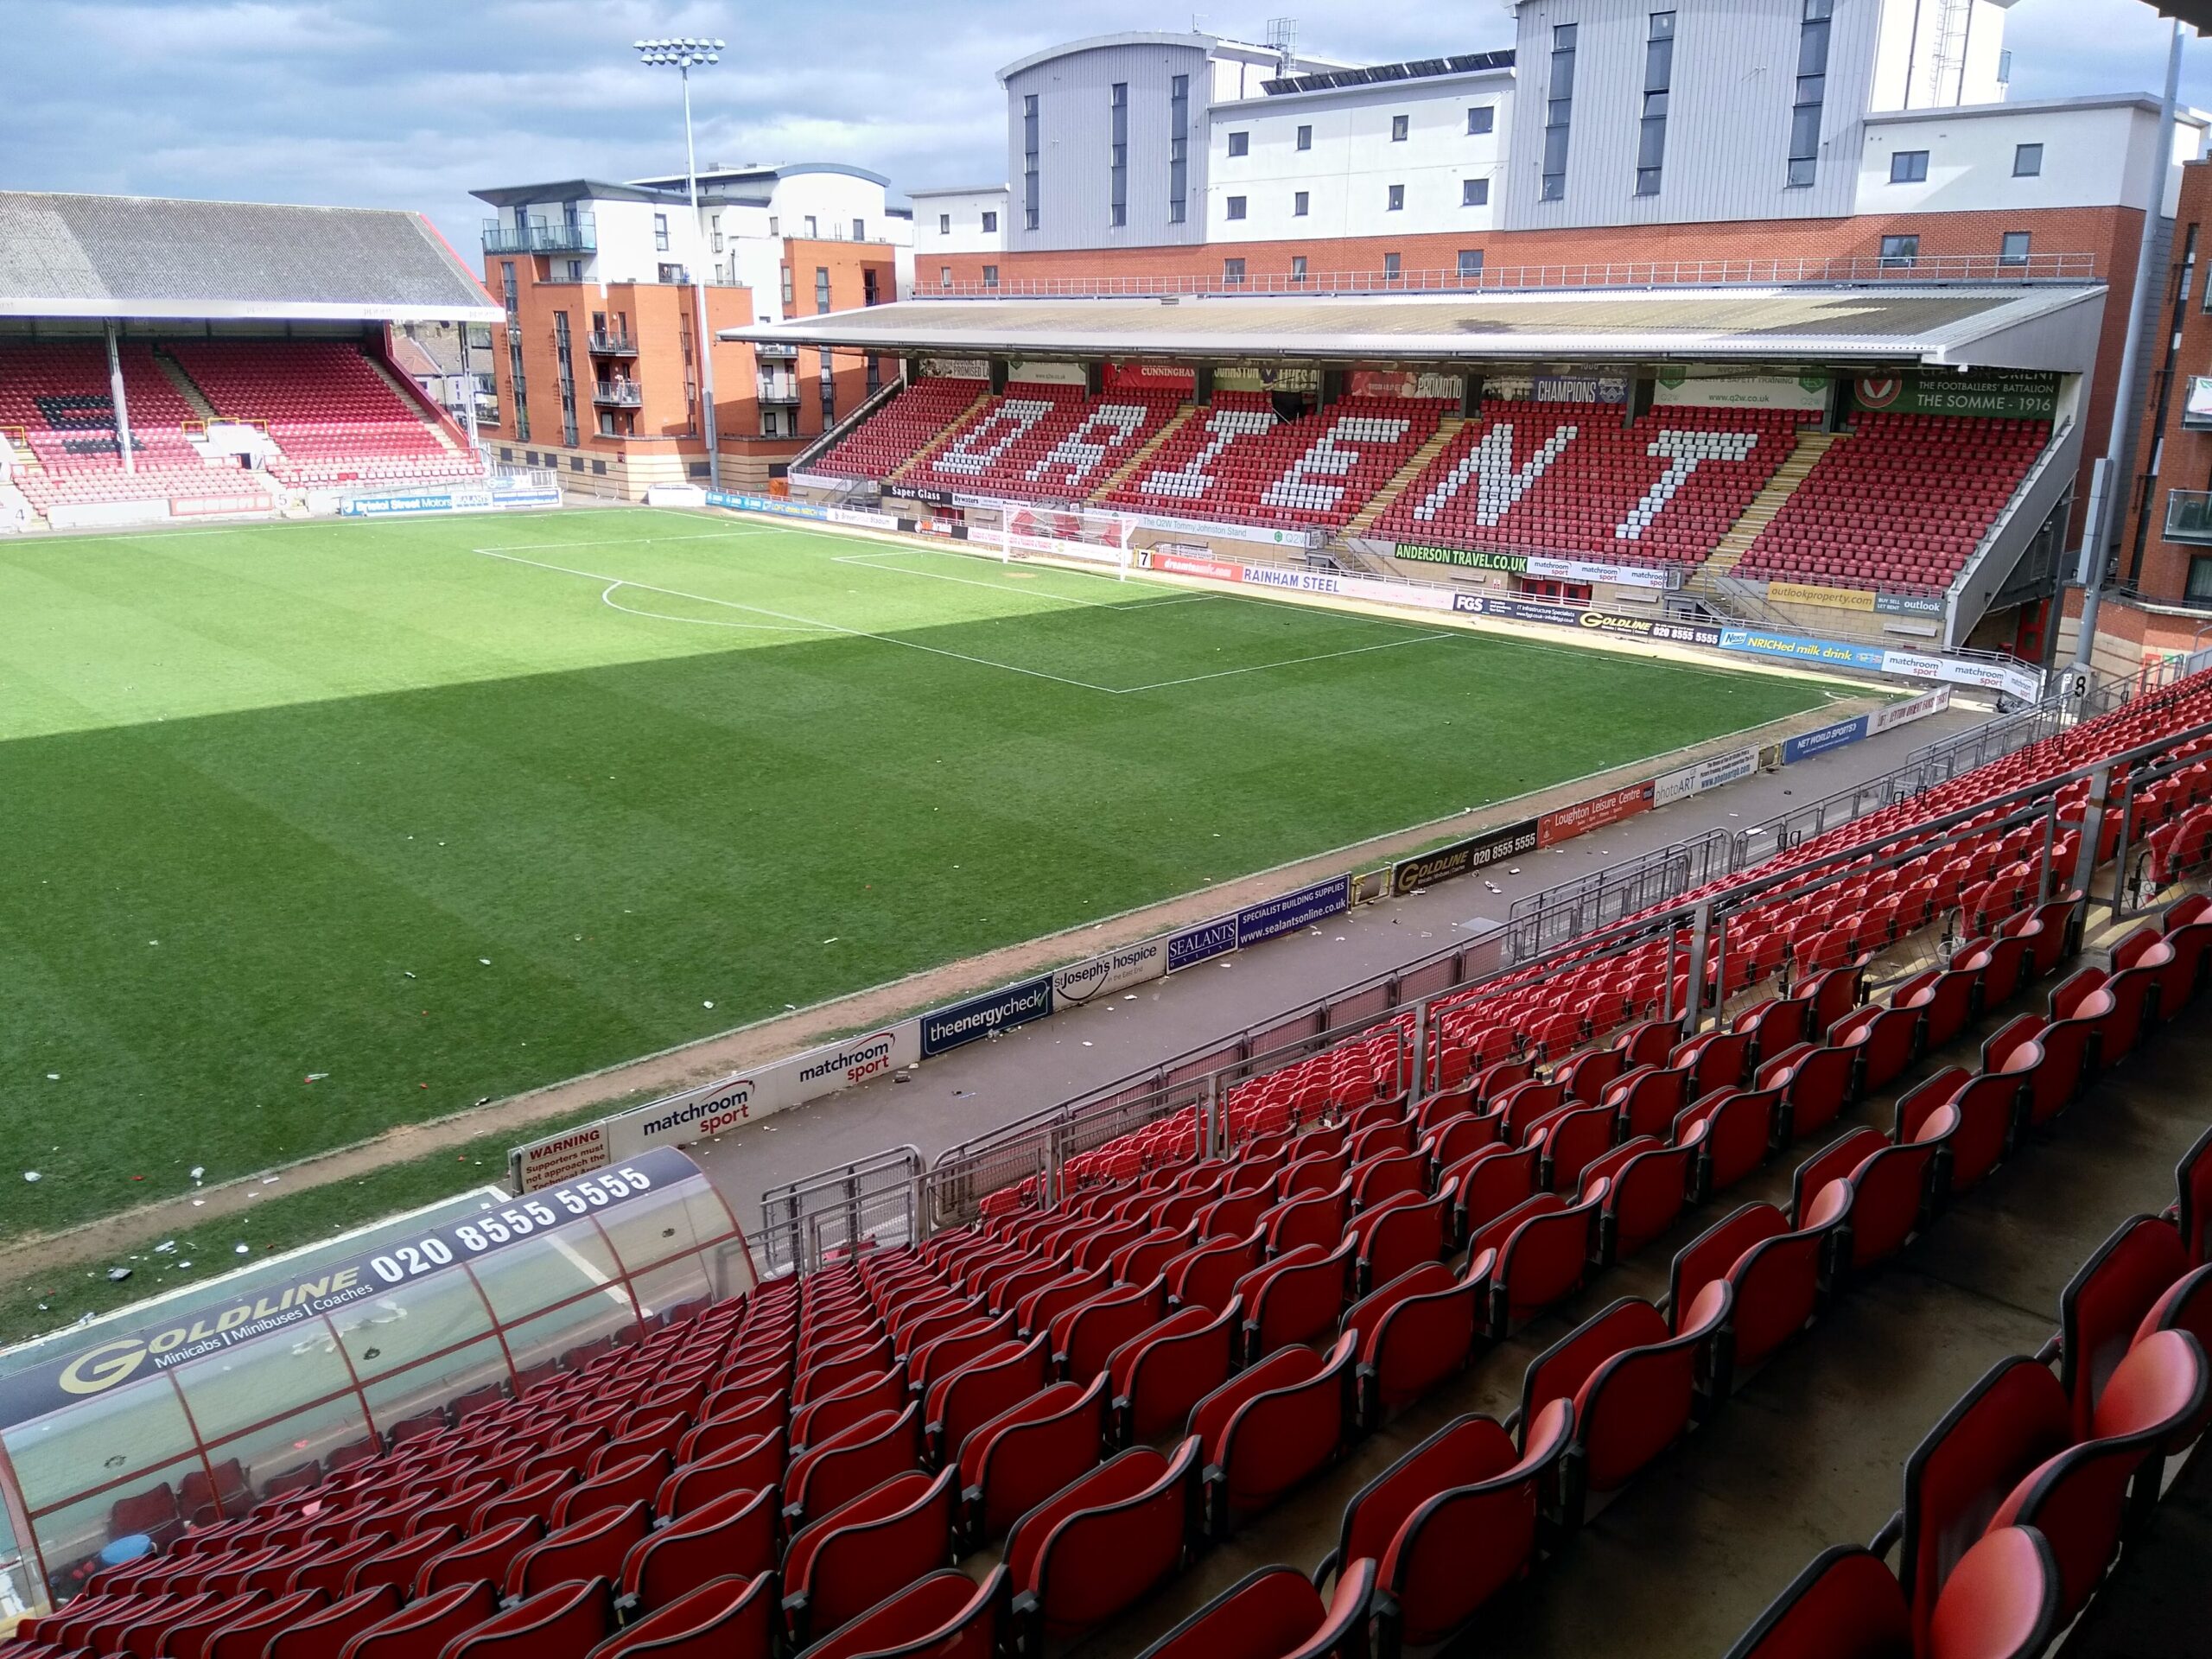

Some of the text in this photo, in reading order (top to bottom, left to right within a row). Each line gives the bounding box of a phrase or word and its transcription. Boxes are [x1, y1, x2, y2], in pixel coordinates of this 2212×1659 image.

[953, 365, 982, 377] PROMISED
[1537, 380, 1596, 403] CHAMPIONS
[1937, 382, 2000, 392] FOOTBALLERS'
[2003, 384, 2054, 393] BATTALION
[1708, 394, 1770, 403] www.q2w.co.uk
[1917, 394, 2050, 411] THE SOMME 1916
[422, 498, 452, 507] Motors
[892, 486, 915, 499] Saper
[918, 489, 941, 500] Glass
[954, 495, 979, 505] Bywaters
[1143, 518, 1155, 526] The
[1173, 521, 1196, 533] Tommy
[1196, 524, 1225, 535] Johnston
[1227, 527, 1247, 537] Stand
[1141, 552, 1148, 565] 7
[1395, 544, 1527, 572] ANDERSON TRAVEL.CO.UK
[1535, 560, 1569, 570] matchroom
[1244, 569, 1339, 593] RAINHAM STEEL
[1581, 566, 1618, 575] matchroom
[1599, 574, 1618, 582] sport
[1457, 596, 1484, 612] FGS
[1771, 587, 1872, 606] outlookproperty.com
[1904, 600, 1941, 613] outlook
[1522, 605, 1552, 614] Infrastructure
[1551, 609, 1575, 618] Specialists
[1580, 612, 1653, 631] GOLDLINE
[1653, 627, 1670, 638] 020
[1671, 629, 1694, 641] 8555
[1695, 633, 1718, 645] 5555
[1747, 637, 1853, 661] NRICHed milk drink
[1889, 657, 1939, 670] matchroom
[1913, 667, 1937, 677] sport
[1955, 666, 2004, 680] matchroom
[1980, 677, 2003, 687] sport
[2011, 677, 2031, 690] matchroom
[2074, 676, 2086, 697] 8
[2019, 690, 2031, 699] sport
[1890, 707, 1907, 723] LEYTON
[1906, 702, 1922, 715] ORIENT
[1797, 738, 1814, 749] NET
[1815, 731, 1831, 747] WORLD
[1831, 724, 1853, 738] SPORTS
[1700, 764, 1751, 789] www.photoartgb.com
[1656, 775, 1696, 803] photoART
[1555, 806, 1590, 827] Loughton
[1592, 796, 1617, 814] Leisure
[1618, 788, 1641, 805] Centre
[1473, 849, 1491, 866] 020
[1492, 841, 1513, 860] 8555
[1514, 833, 1535, 851] 5555
[1398, 850, 1470, 891] GOLDLINE
[1243, 881, 1344, 924] SPECIALIST BUILDING SUPPLIES
[1240, 899, 1346, 944] www.sealantsonline.co.uk
[1169, 922, 1236, 957] SEALANTS
[1113, 944, 1157, 970] hospice
[1113, 972, 1122, 982] the
[1122, 969, 1135, 979] East
[1135, 966, 1143, 976] End
[931, 990, 1042, 1042] theenergycheck
[800, 1041, 888, 1082] matchroom
[847, 1055, 889, 1082] sport
[644, 1090, 747, 1136] matchroom
[700, 1103, 749, 1134] sport
[530, 1129, 600, 1160] WARNING
[526, 1143, 604, 1174] Supporters must
[526, 1154, 606, 1185] not approach the
[370, 1167, 652, 1283] 020 8555 5555
[59, 1265, 360, 1395] GOLDLINE
[154, 1282, 373, 1369] Minicabs Minibuses Coaches
